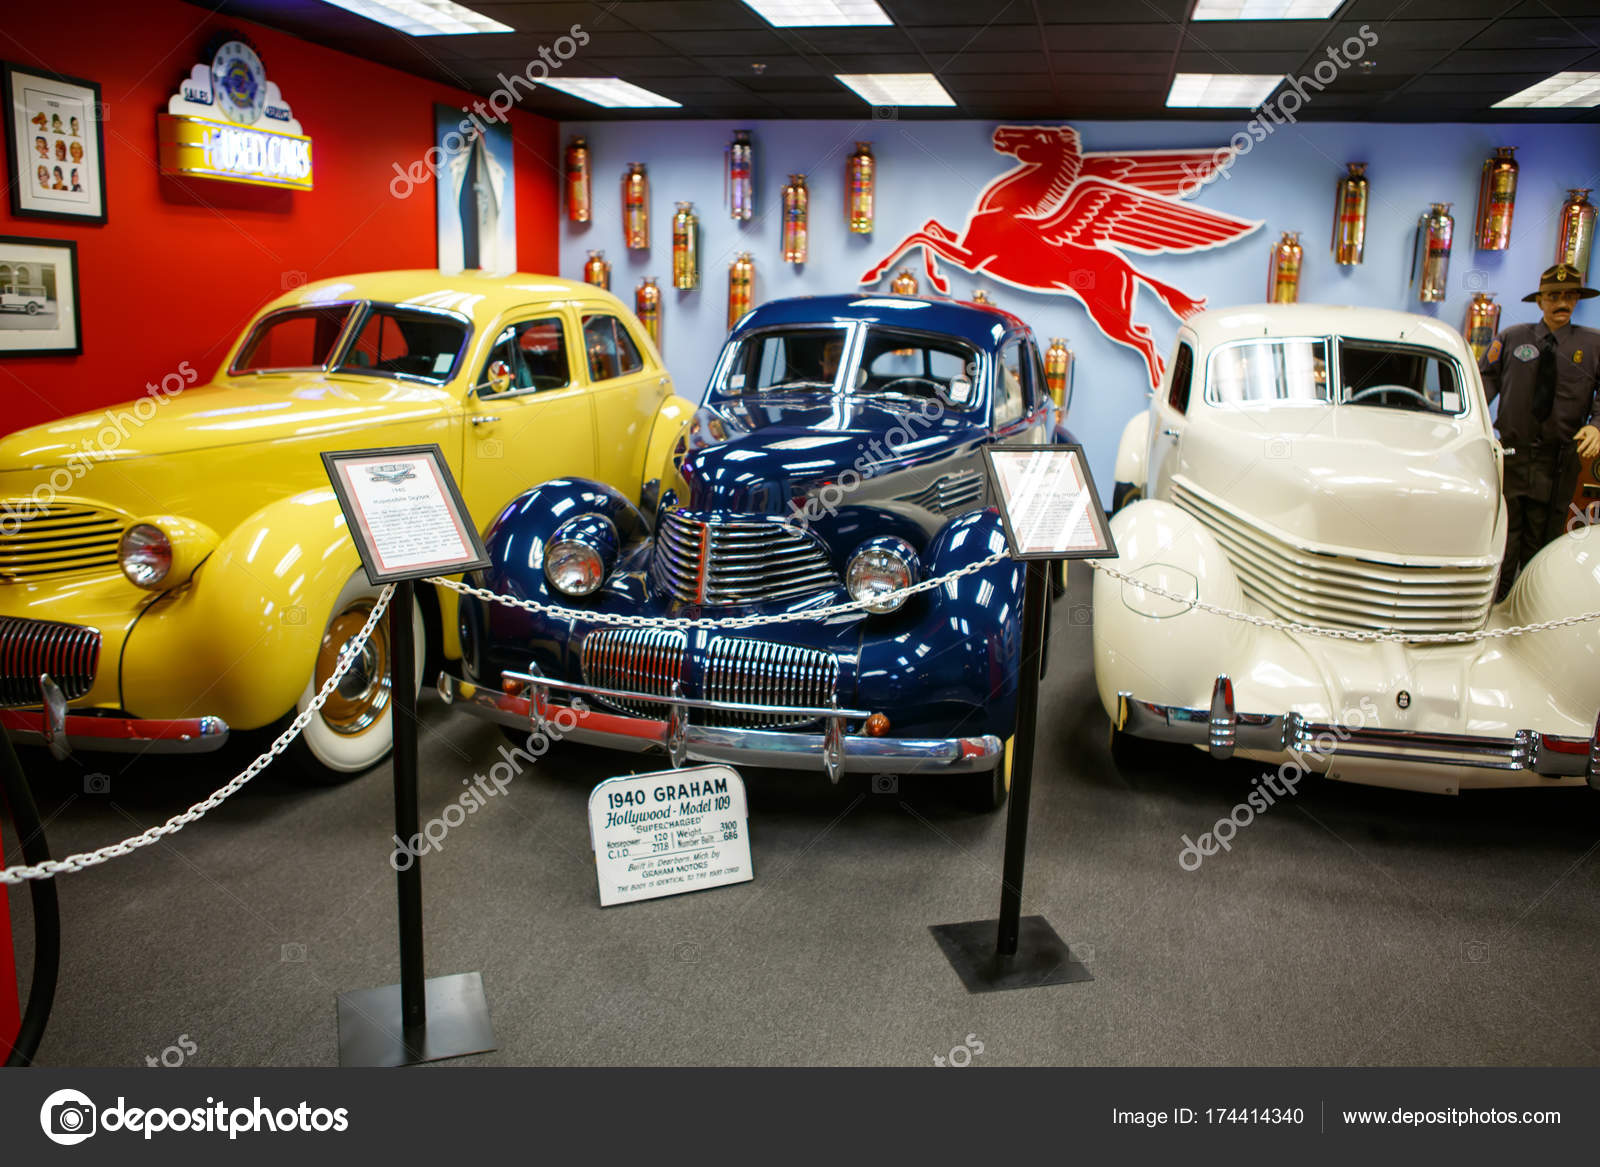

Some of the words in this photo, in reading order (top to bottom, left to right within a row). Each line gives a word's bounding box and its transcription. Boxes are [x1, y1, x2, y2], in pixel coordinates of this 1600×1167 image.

[608, 790, 645, 809] 1940
[654, 778, 727, 802] GRAHAM
[605, 805, 671, 829] Hollywood
[680, 800, 711, 816] Model
[715, 796, 731, 811] 109
[654, 833, 668, 842] 120
[676, 828, 702, 838] Weight
[719, 820, 737, 832] 3100
[642, 866, 674, 878] GRAHAM
[676, 861, 708, 873] MOTORS
